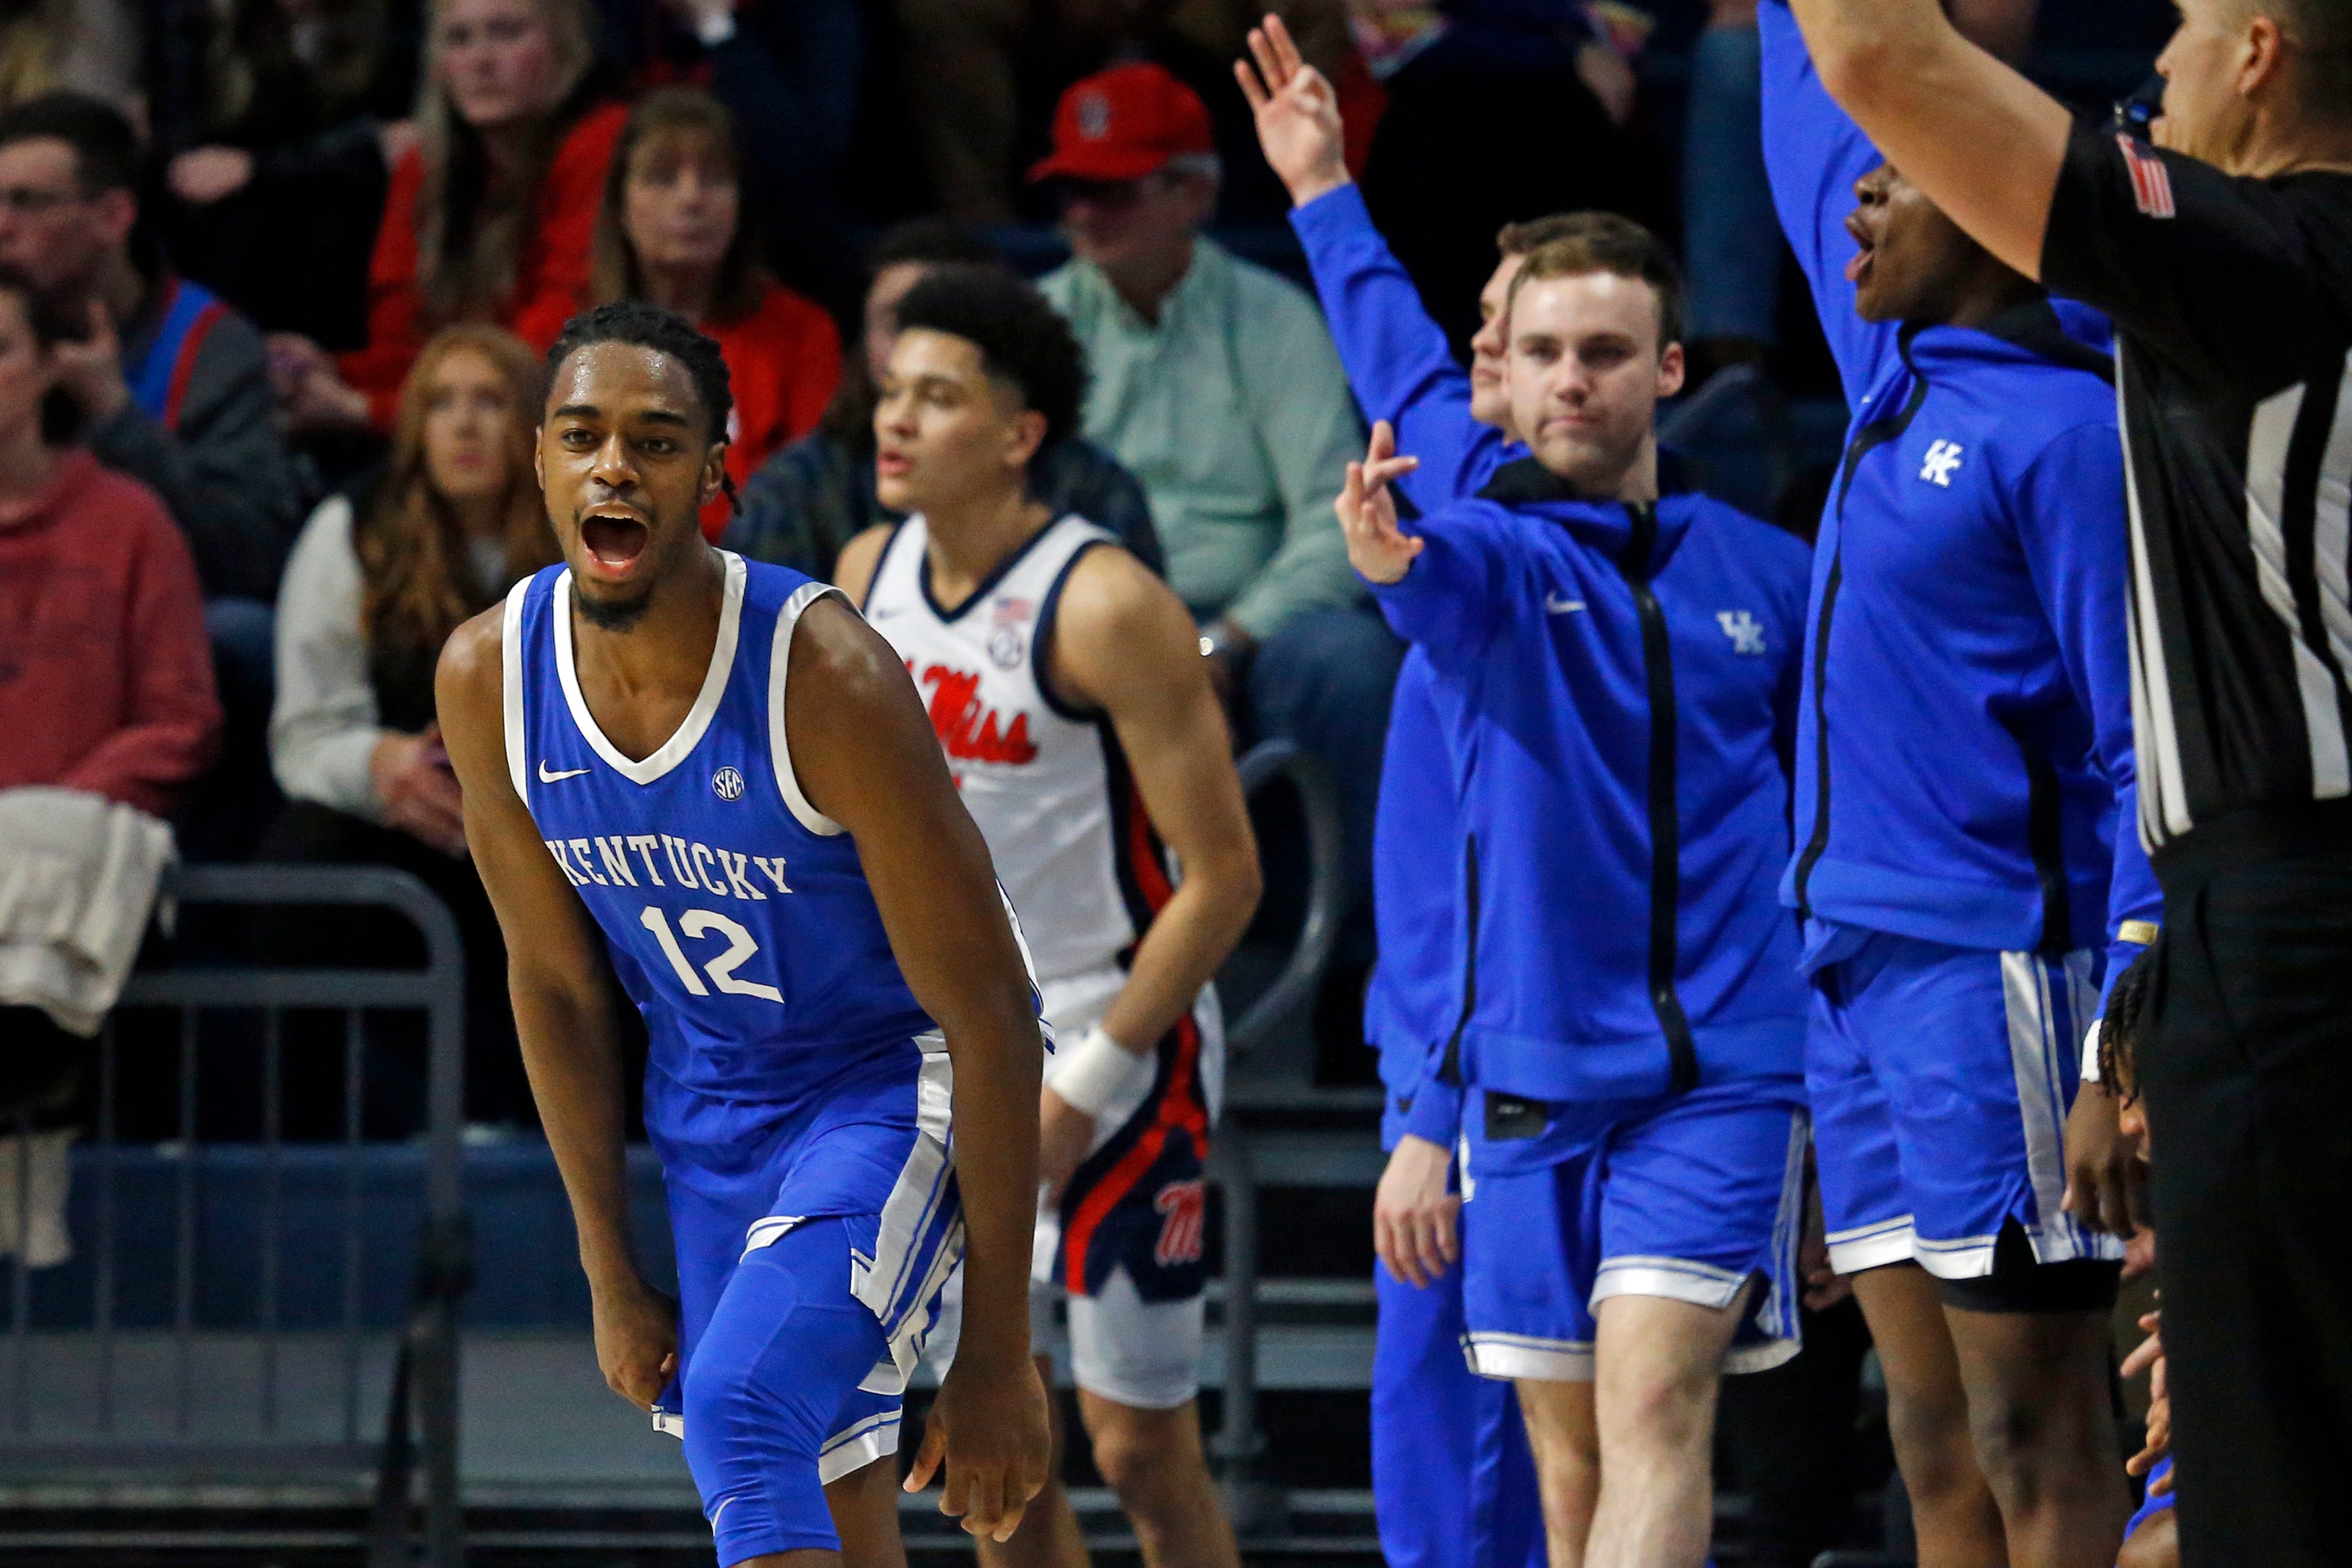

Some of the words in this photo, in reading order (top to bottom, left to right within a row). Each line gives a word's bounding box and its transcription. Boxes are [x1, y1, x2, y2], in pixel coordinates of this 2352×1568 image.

[715, 770, 742, 798] SEC
[544, 834, 793, 901] KENTUCKY
[640, 905, 784, 1004] 12
